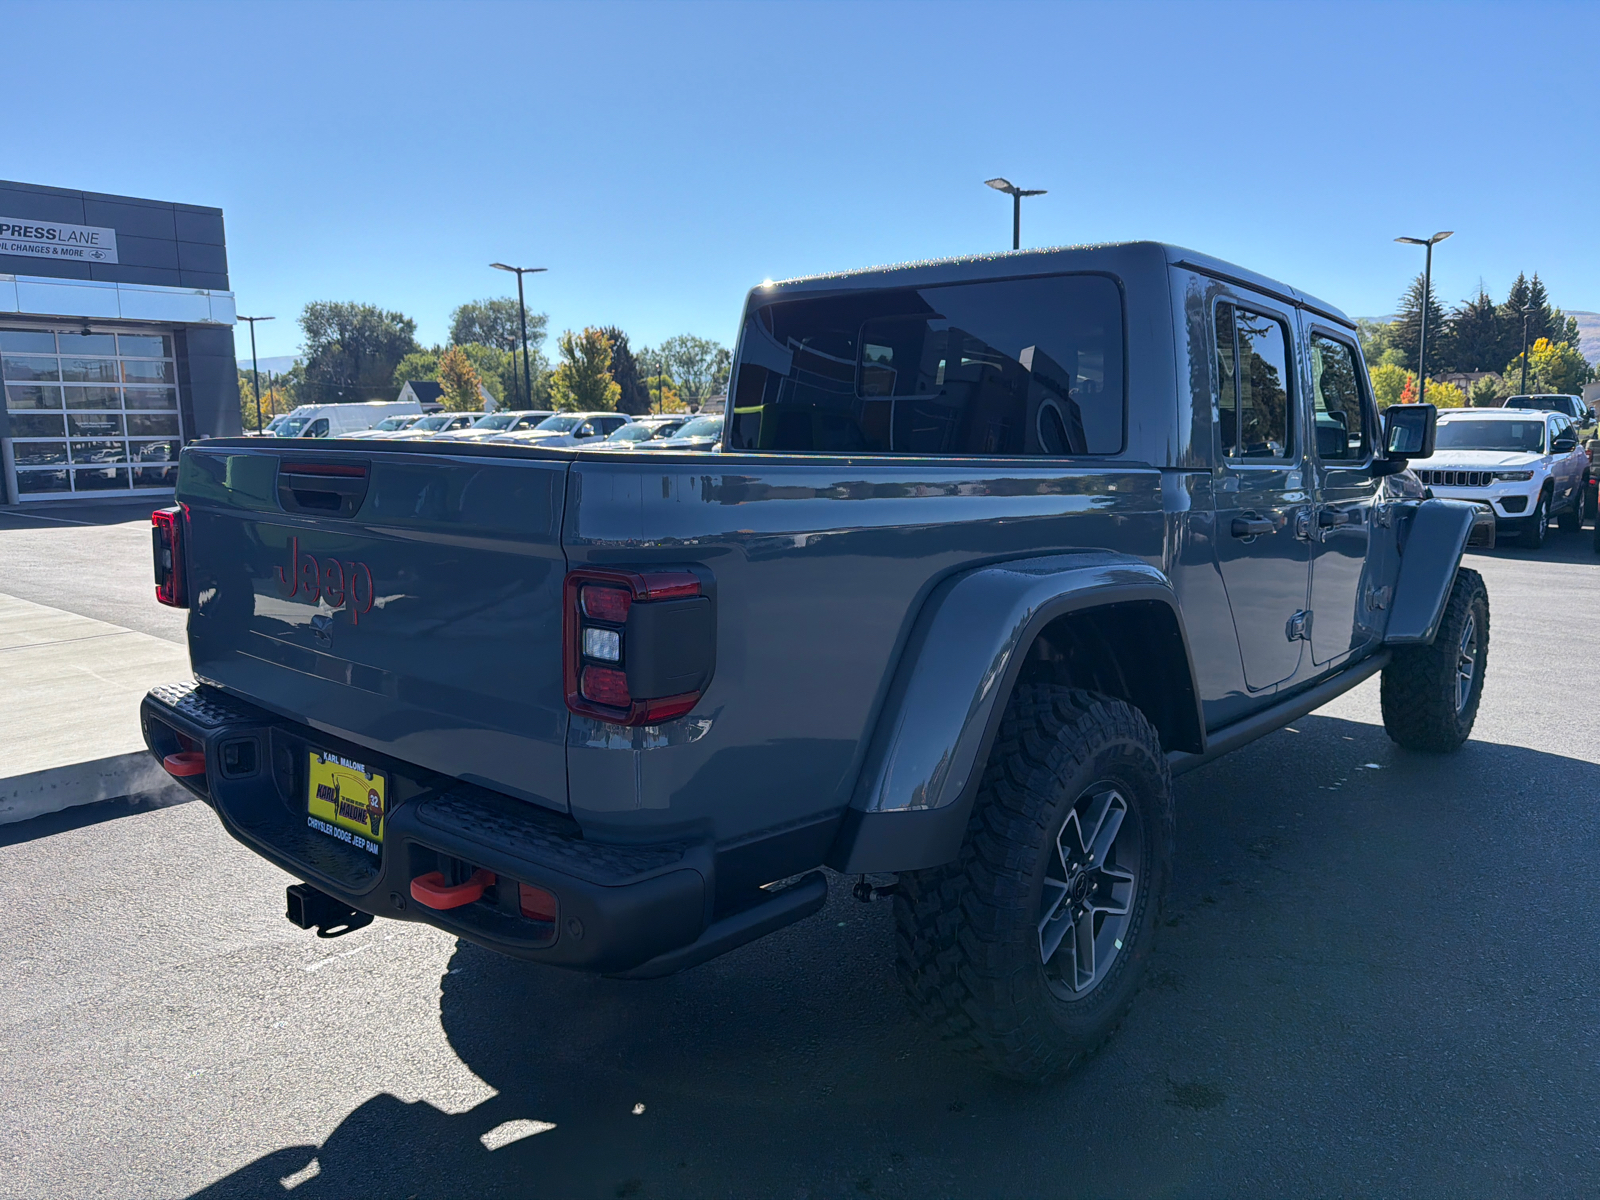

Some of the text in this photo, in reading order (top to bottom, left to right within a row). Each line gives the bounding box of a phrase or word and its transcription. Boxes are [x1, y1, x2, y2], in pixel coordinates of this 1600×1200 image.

[0, 242, 84, 257] IL CHANGES & MORE
[273, 536, 373, 626] Jeep
[323, 751, 365, 773] KARL MALONE
[316, 783, 336, 803] KARL
[370, 794, 379, 808] 32
[339, 801, 368, 825] MALONE
[307, 816, 379, 855] CHRYSLER DODGE JEEP RAM
